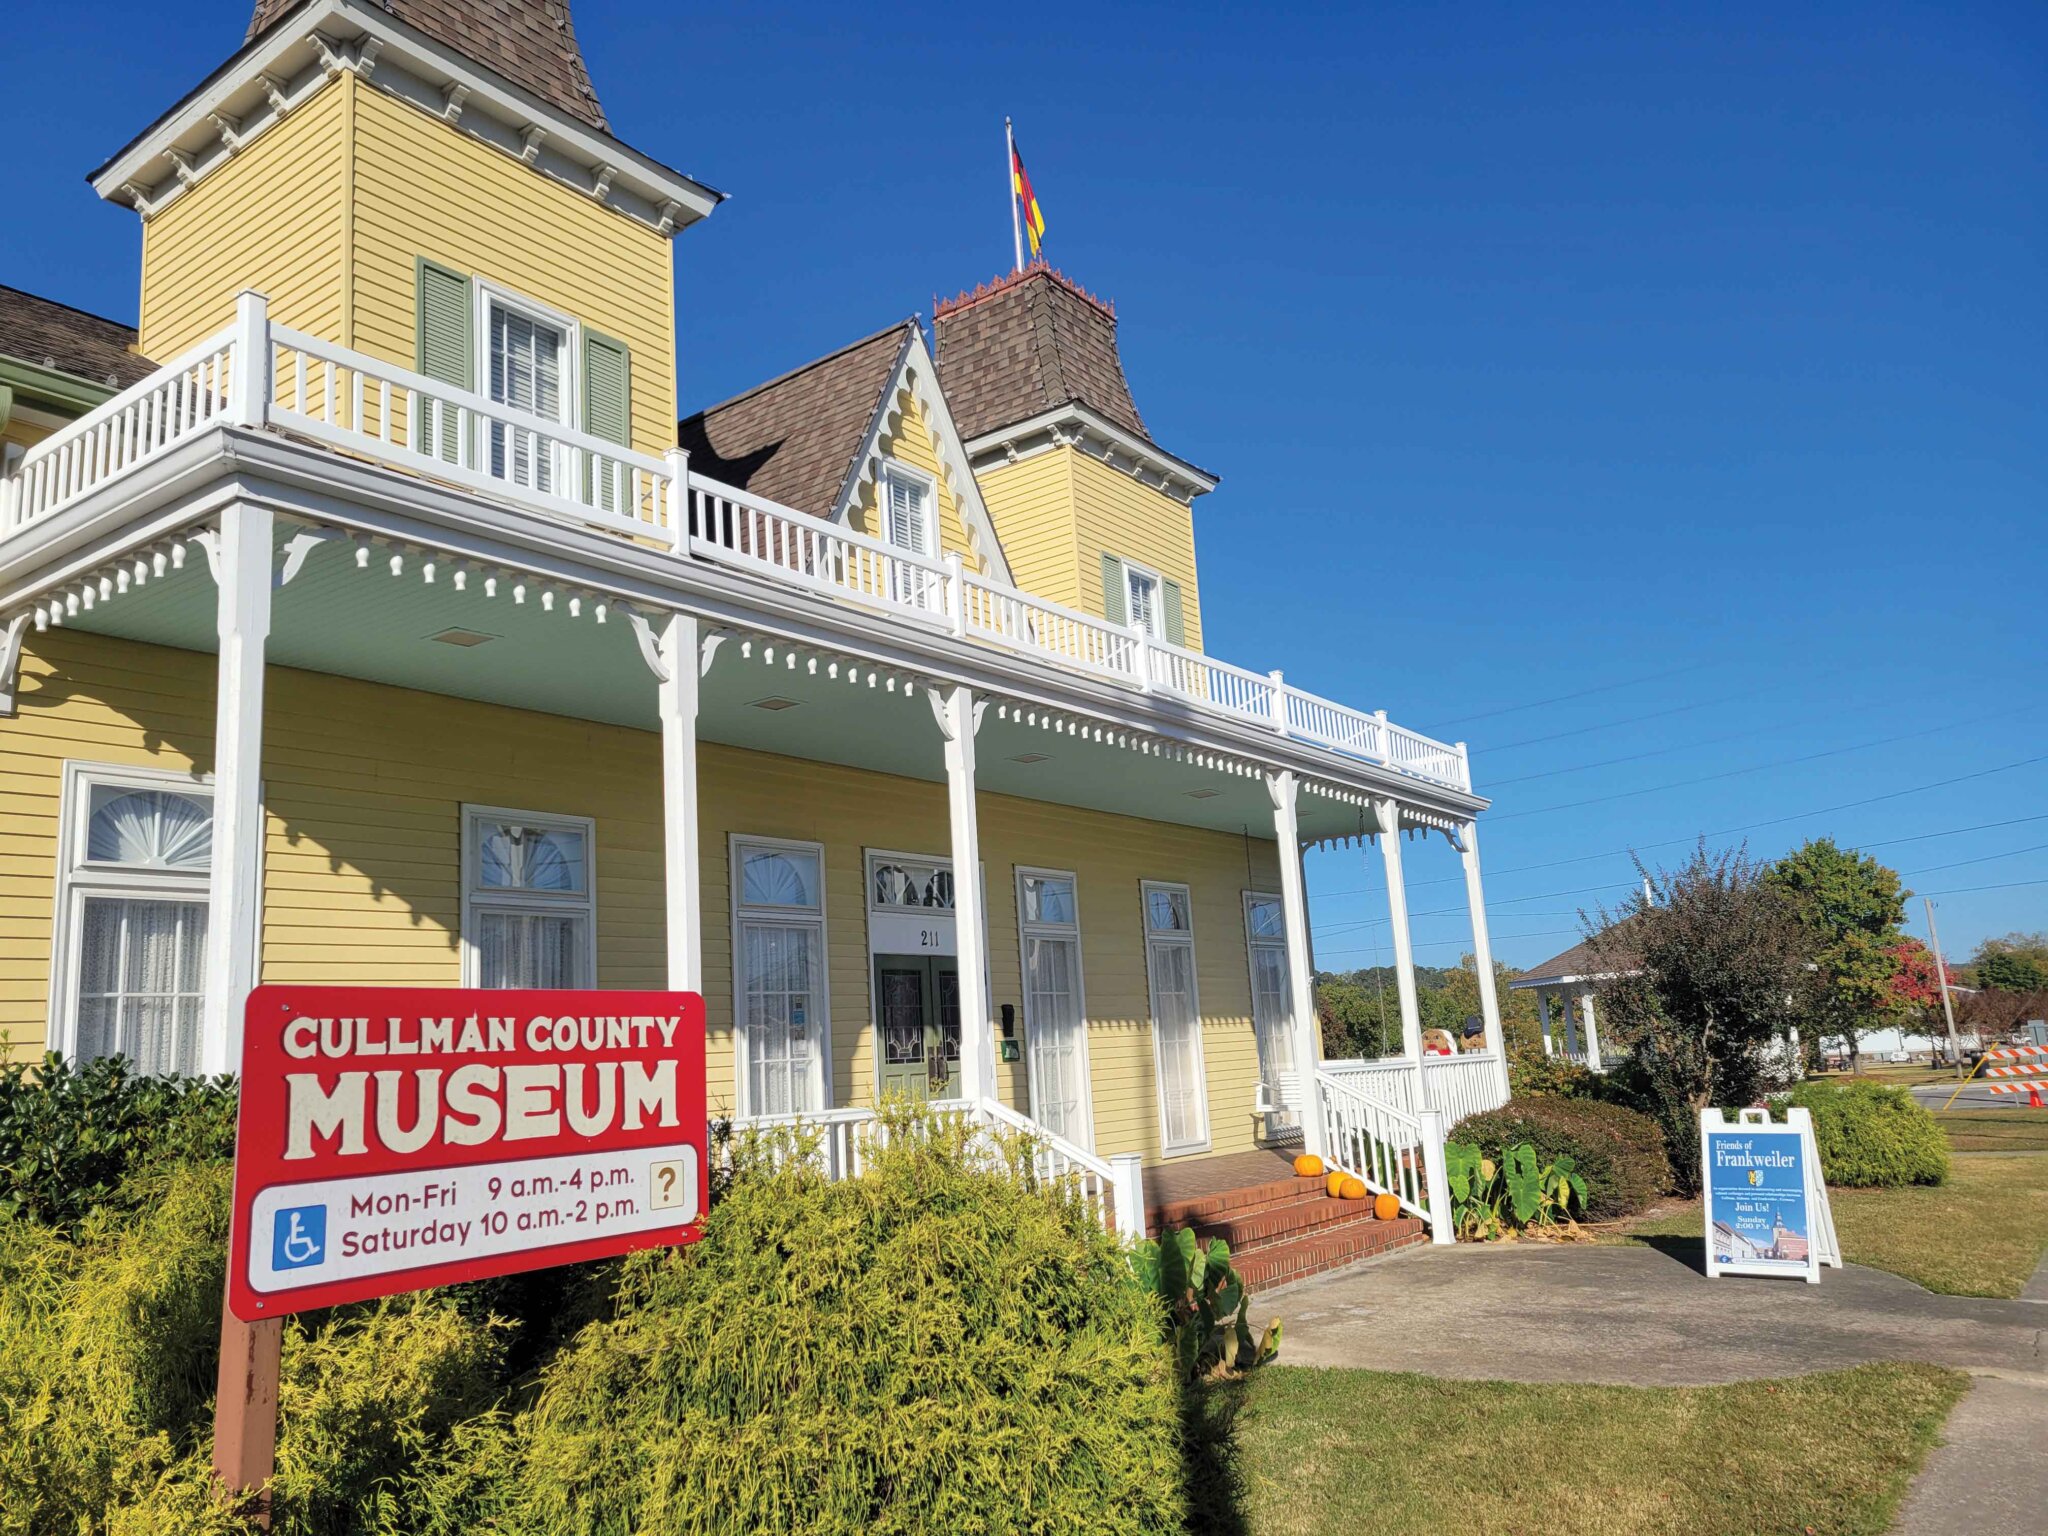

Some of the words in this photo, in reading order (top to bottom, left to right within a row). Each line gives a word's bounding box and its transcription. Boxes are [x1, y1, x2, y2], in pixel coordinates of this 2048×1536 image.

[921, 930, 939, 948] 211
[282, 1014, 516, 1059] CULLMAN
[525, 1016, 681, 1053] COUNTY
[284, 1060, 680, 1160] MUSEUM
[1716, 1140, 1743, 1150] Friends
[1744, 1140, 1753, 1150] of
[1716, 1150, 1795, 1168] Frankweiler
[350, 1181, 458, 1219] Mon-Fri
[487, 1177, 502, 1200] 9
[511, 1164, 583, 1198] a.m.-4
[590, 1164, 635, 1192] p.m.
[1735, 1202, 1753, 1212] Join
[1755, 1203, 1770, 1212] Us!
[342, 1219, 471, 1258] Saturday
[480, 1211, 507, 1237] 10
[517, 1200, 588, 1231] a.m.-2
[595, 1196, 640, 1223] p.m.
[1737, 1215, 1766, 1223] Sunday
